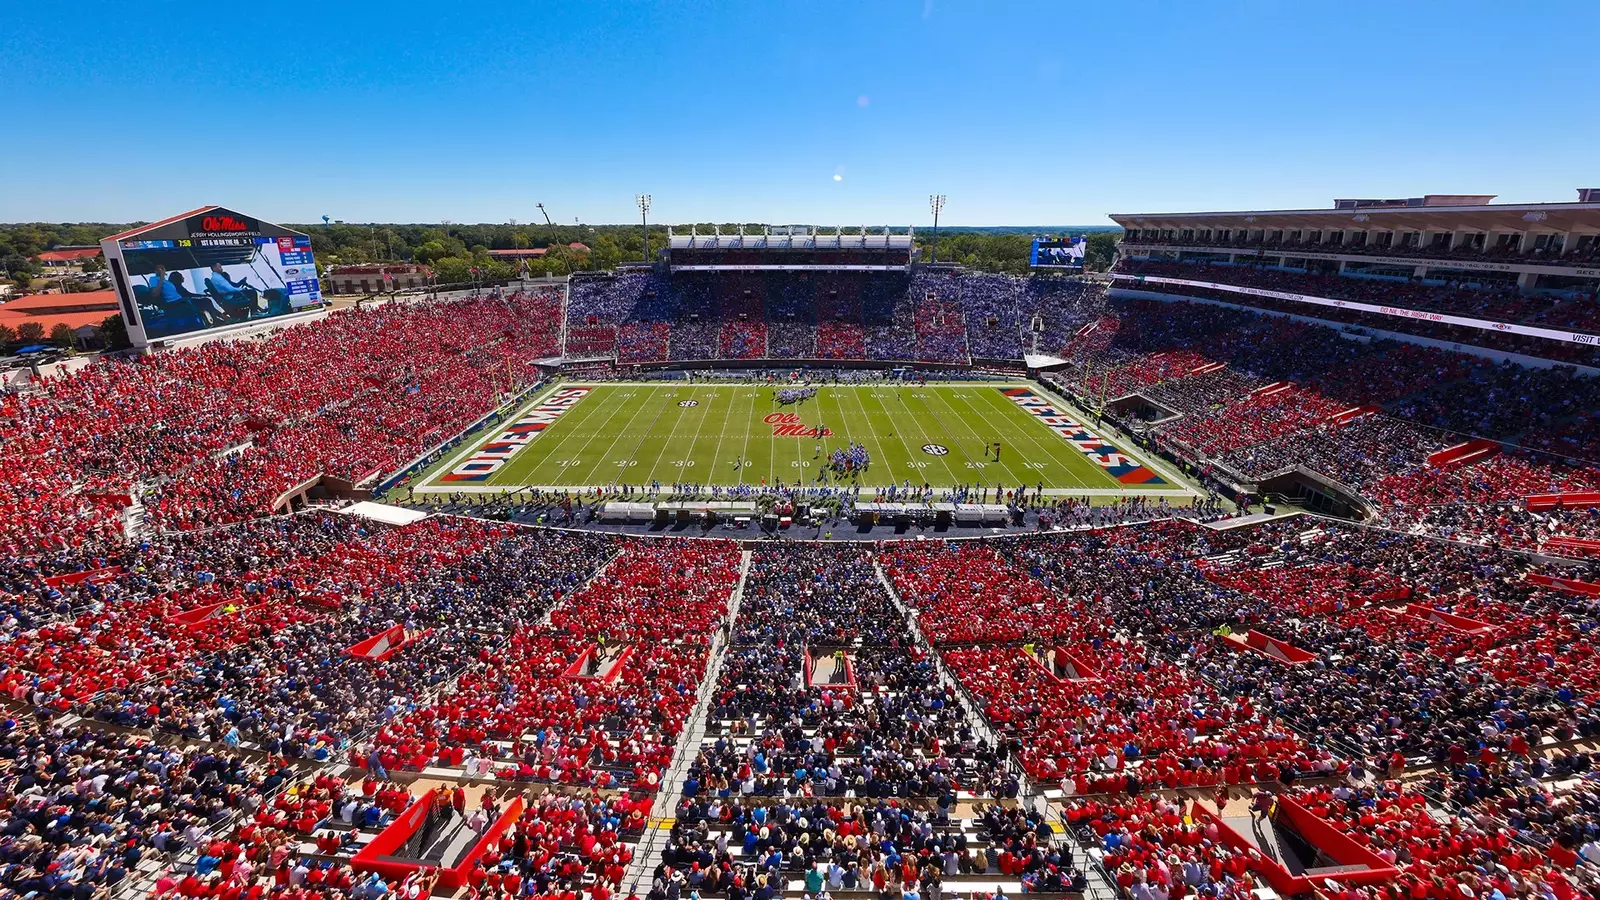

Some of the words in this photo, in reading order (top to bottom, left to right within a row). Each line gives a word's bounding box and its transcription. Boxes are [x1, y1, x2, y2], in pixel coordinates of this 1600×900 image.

[203, 216, 220, 231] Ole
[219, 216, 247, 231] Miss
[1572, 334, 1596, 344] VISIT
[762, 412, 801, 425] Ole
[922, 444, 949, 456] SEC
[616, 459, 638, 467] 20
[675, 459, 695, 467] 30
[790, 460, 811, 468] 50
[964, 461, 986, 469] 20
[892, 785, 898, 795] 9
